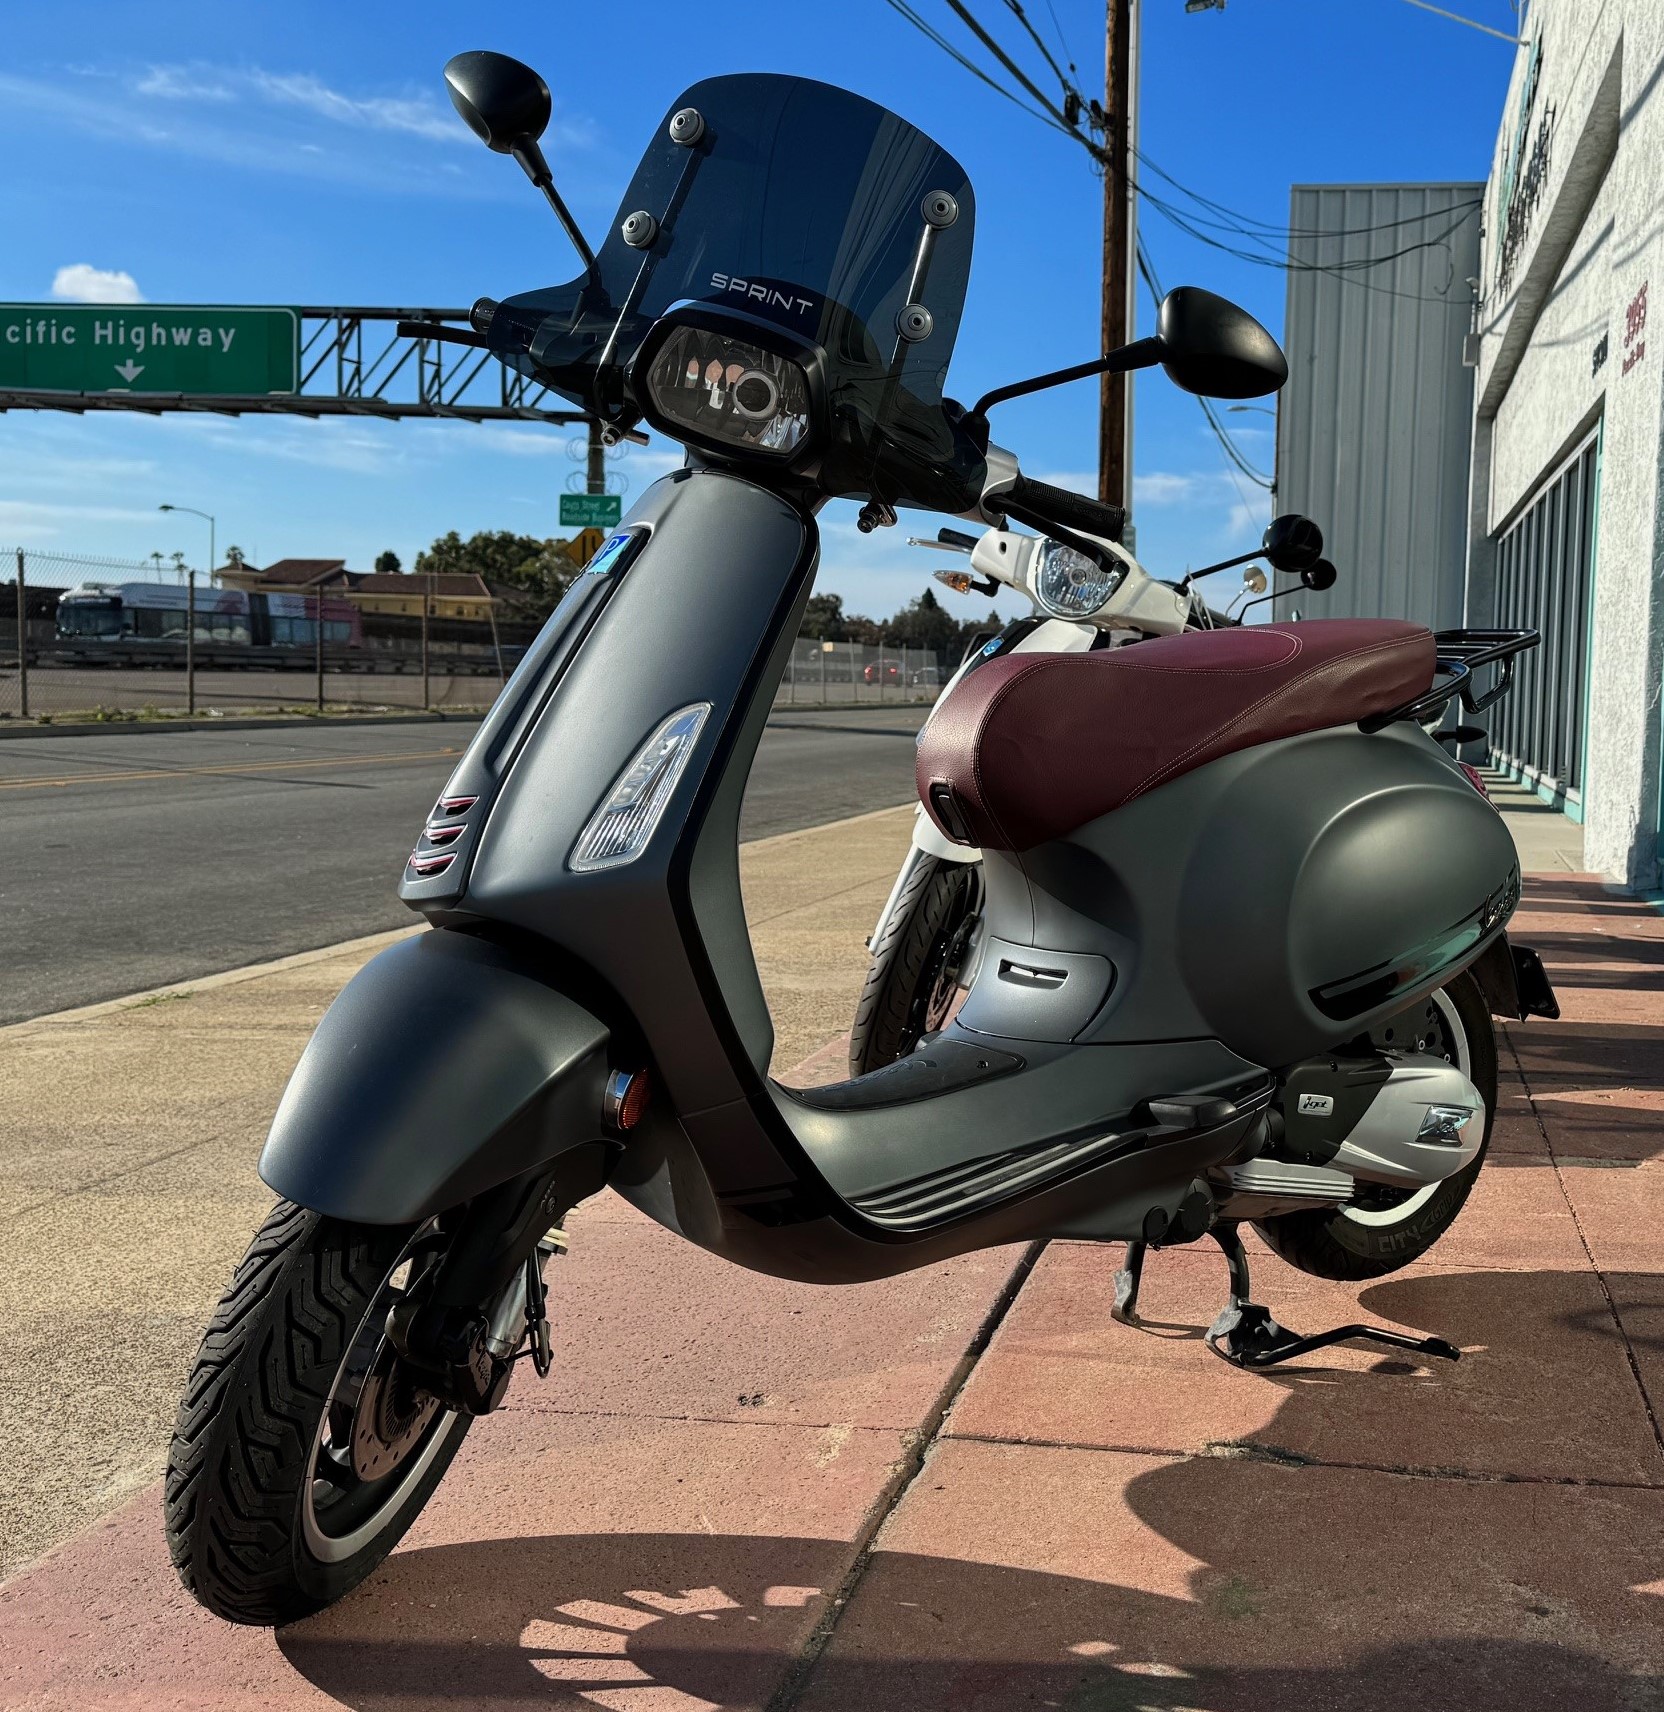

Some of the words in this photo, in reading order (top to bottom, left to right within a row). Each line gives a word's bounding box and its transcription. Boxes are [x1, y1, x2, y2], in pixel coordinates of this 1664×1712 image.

[710, 272, 814, 315] SPRINT
[6, 318, 76, 344] cific
[94, 319, 236, 353] Highway
[1377, 1225, 1421, 1253] CITY
